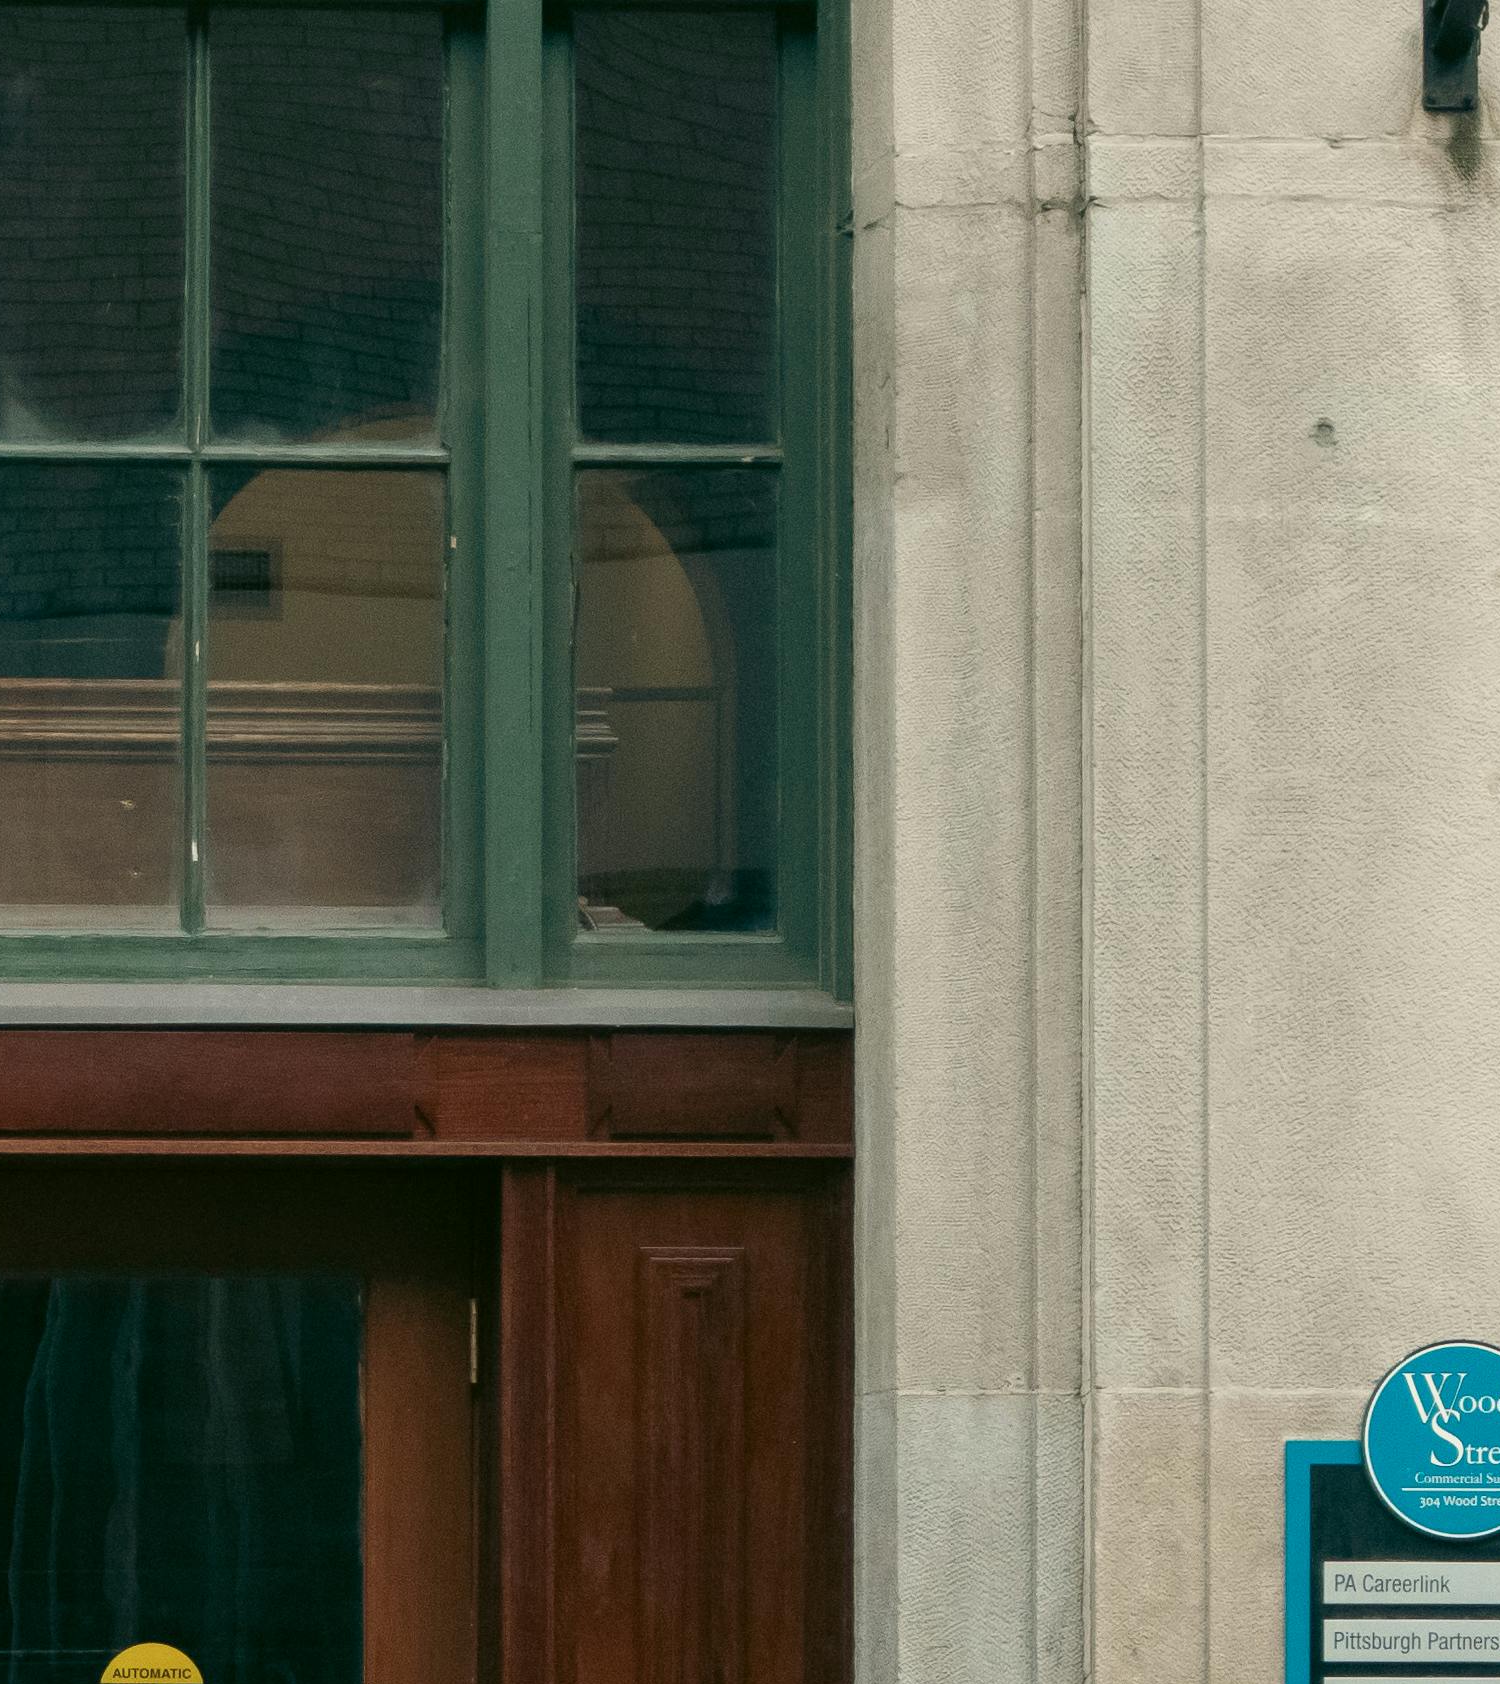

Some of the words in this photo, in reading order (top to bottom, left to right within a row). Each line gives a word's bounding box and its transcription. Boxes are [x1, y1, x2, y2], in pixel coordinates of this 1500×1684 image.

[1415, 1471, 1483, 1484] Commercial
[1419, 1496, 1441, 1509] 304
[1443, 1495, 1478, 1507] Wood
[1334, 1574, 1357, 1593] PA
[1362, 1574, 1451, 1593] Careerlink
[1334, 1631, 1421, 1655] Pittsburgh
[112, 1668, 192, 1680] AUTOMATIC
